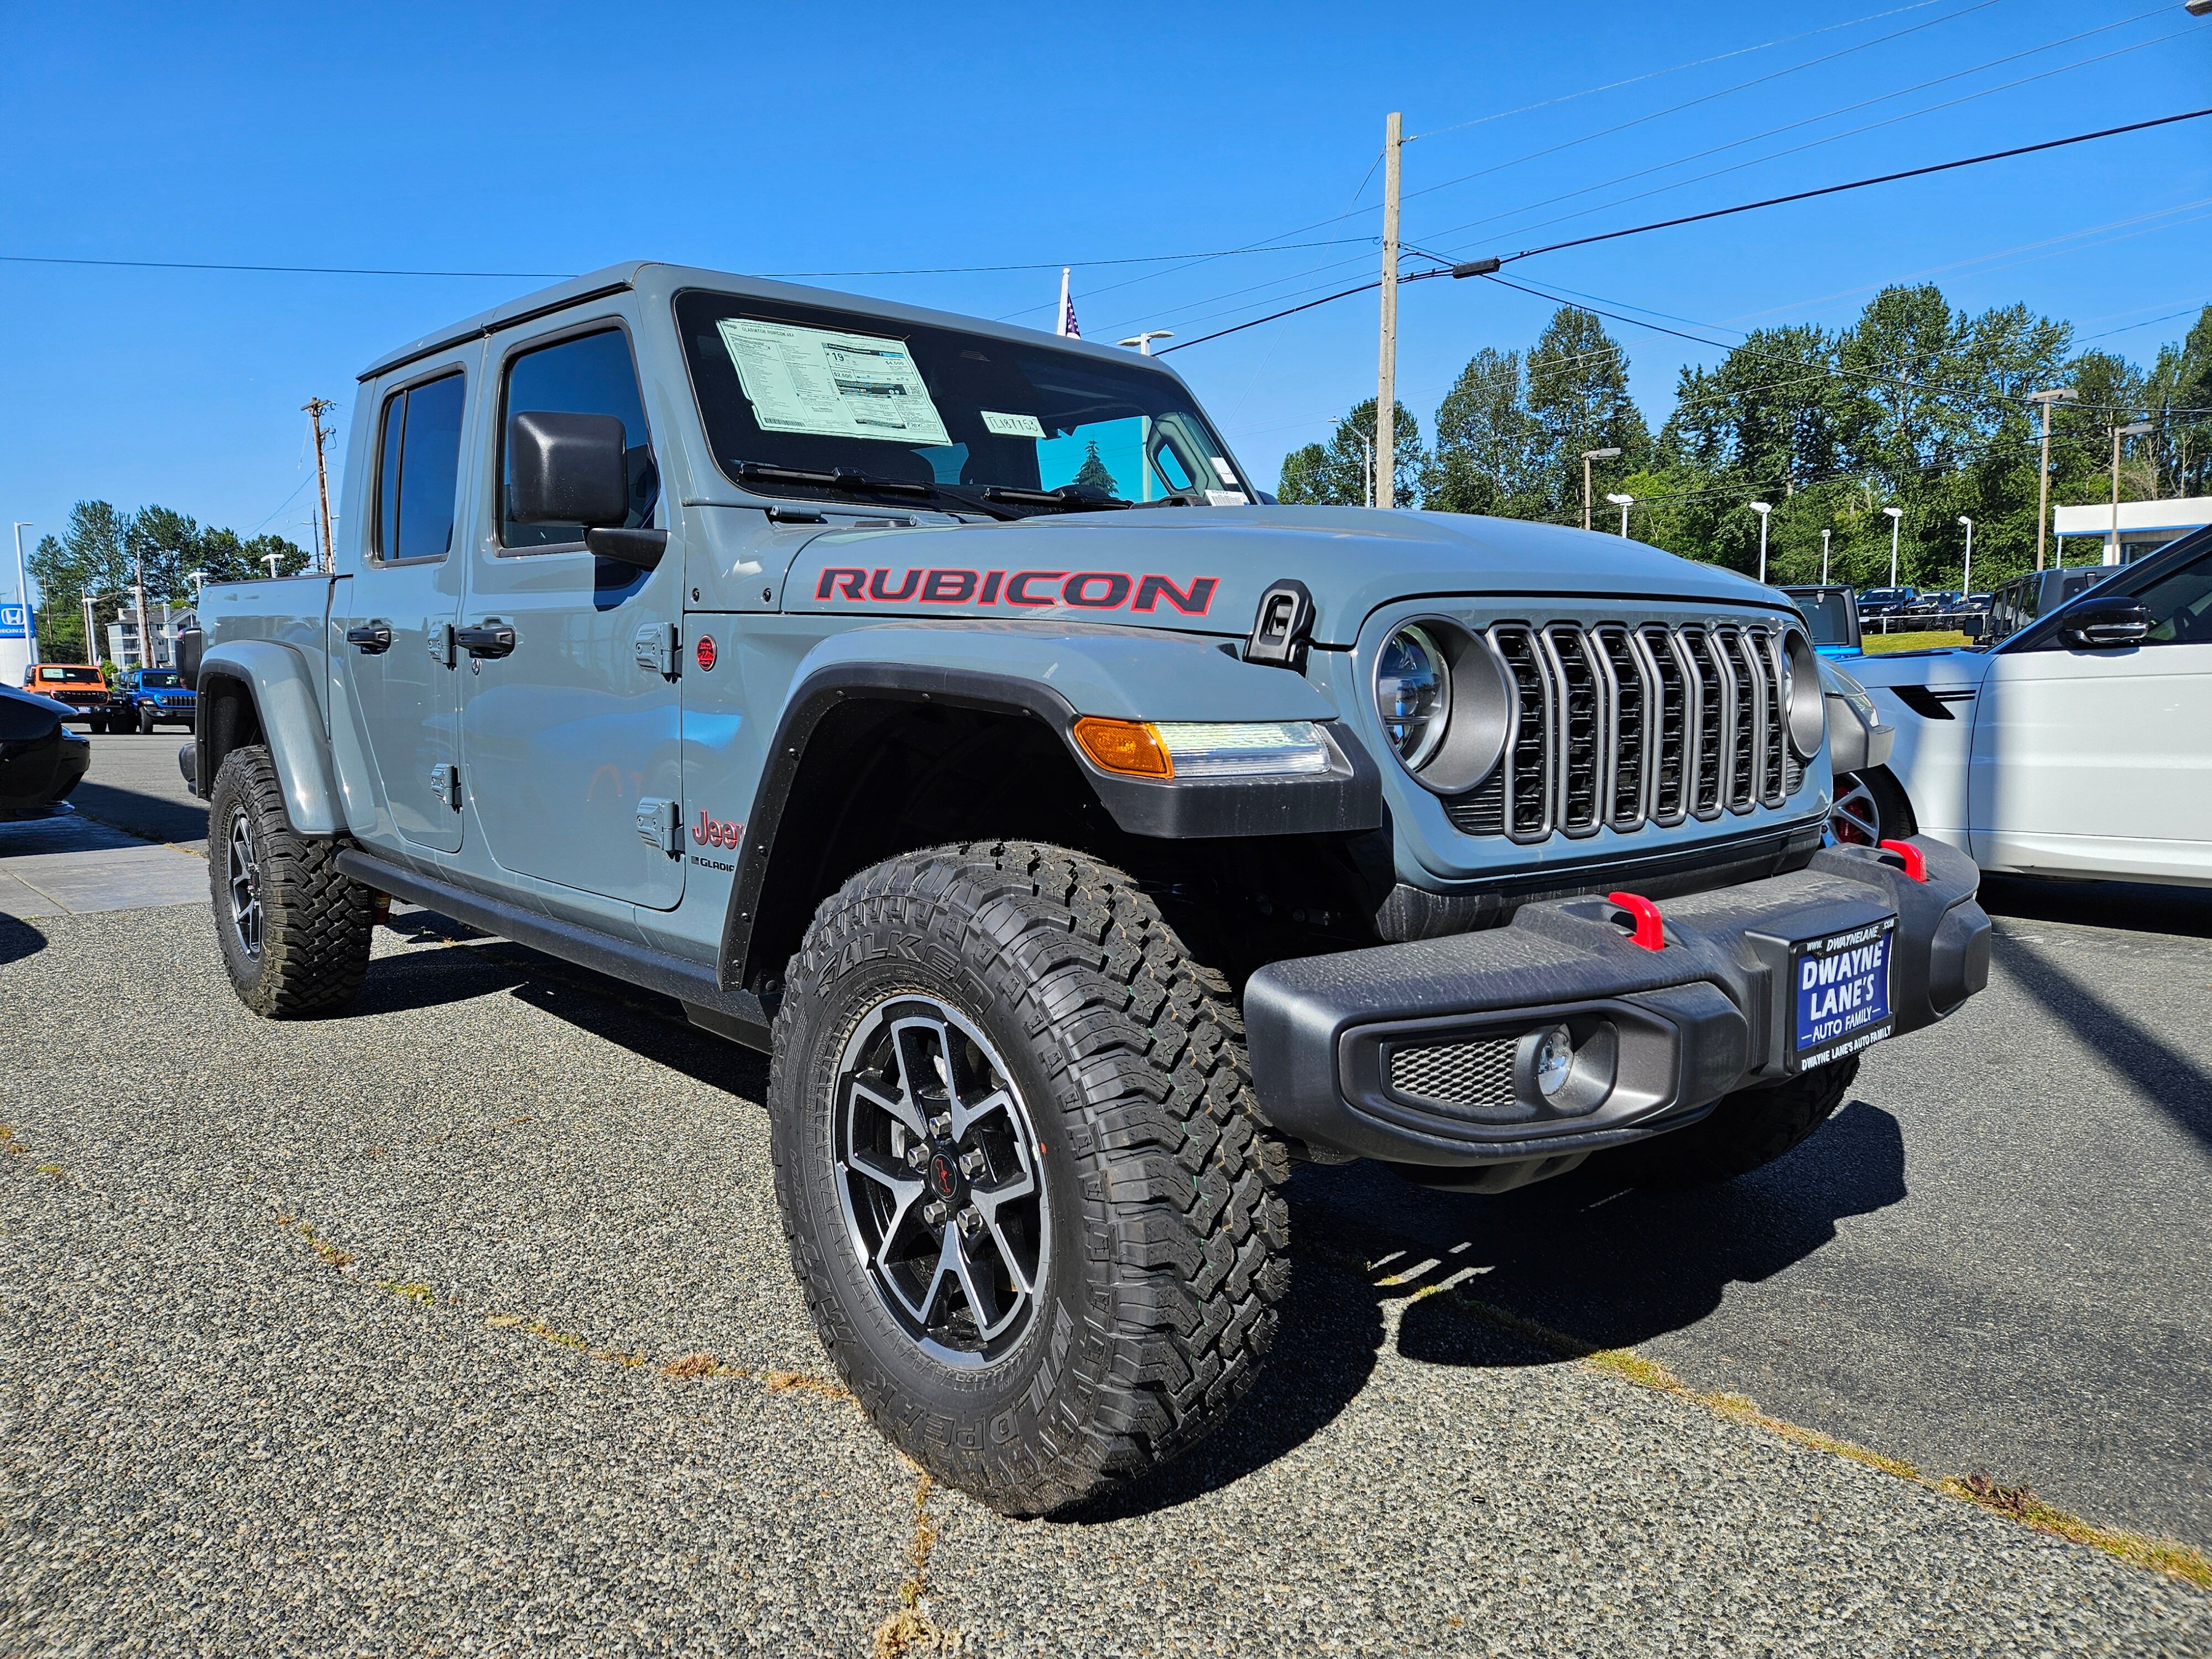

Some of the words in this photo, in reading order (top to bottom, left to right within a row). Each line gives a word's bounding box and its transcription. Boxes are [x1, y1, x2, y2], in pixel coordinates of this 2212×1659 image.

[832, 352, 844, 361] 19
[815, 567, 1220, 615] RUBICON
[1826, 926, 1879, 952] DWAYNELANE
[814, 930, 995, 1015] FALKEN
[1802, 941, 1884, 990] DWAYNE
[1811, 973, 1875, 1021] LANE'S
[1812, 1019, 1843, 1042] AUTO
[1845, 1005, 1872, 1031] FAMILY
[1801, 1049, 1830, 1071] DWAYNE
[1831, 1041, 1853, 1060] LANE'S
[1854, 1034, 1870, 1051] AUTO
[1870, 1025, 1891, 1044] FAMILY
